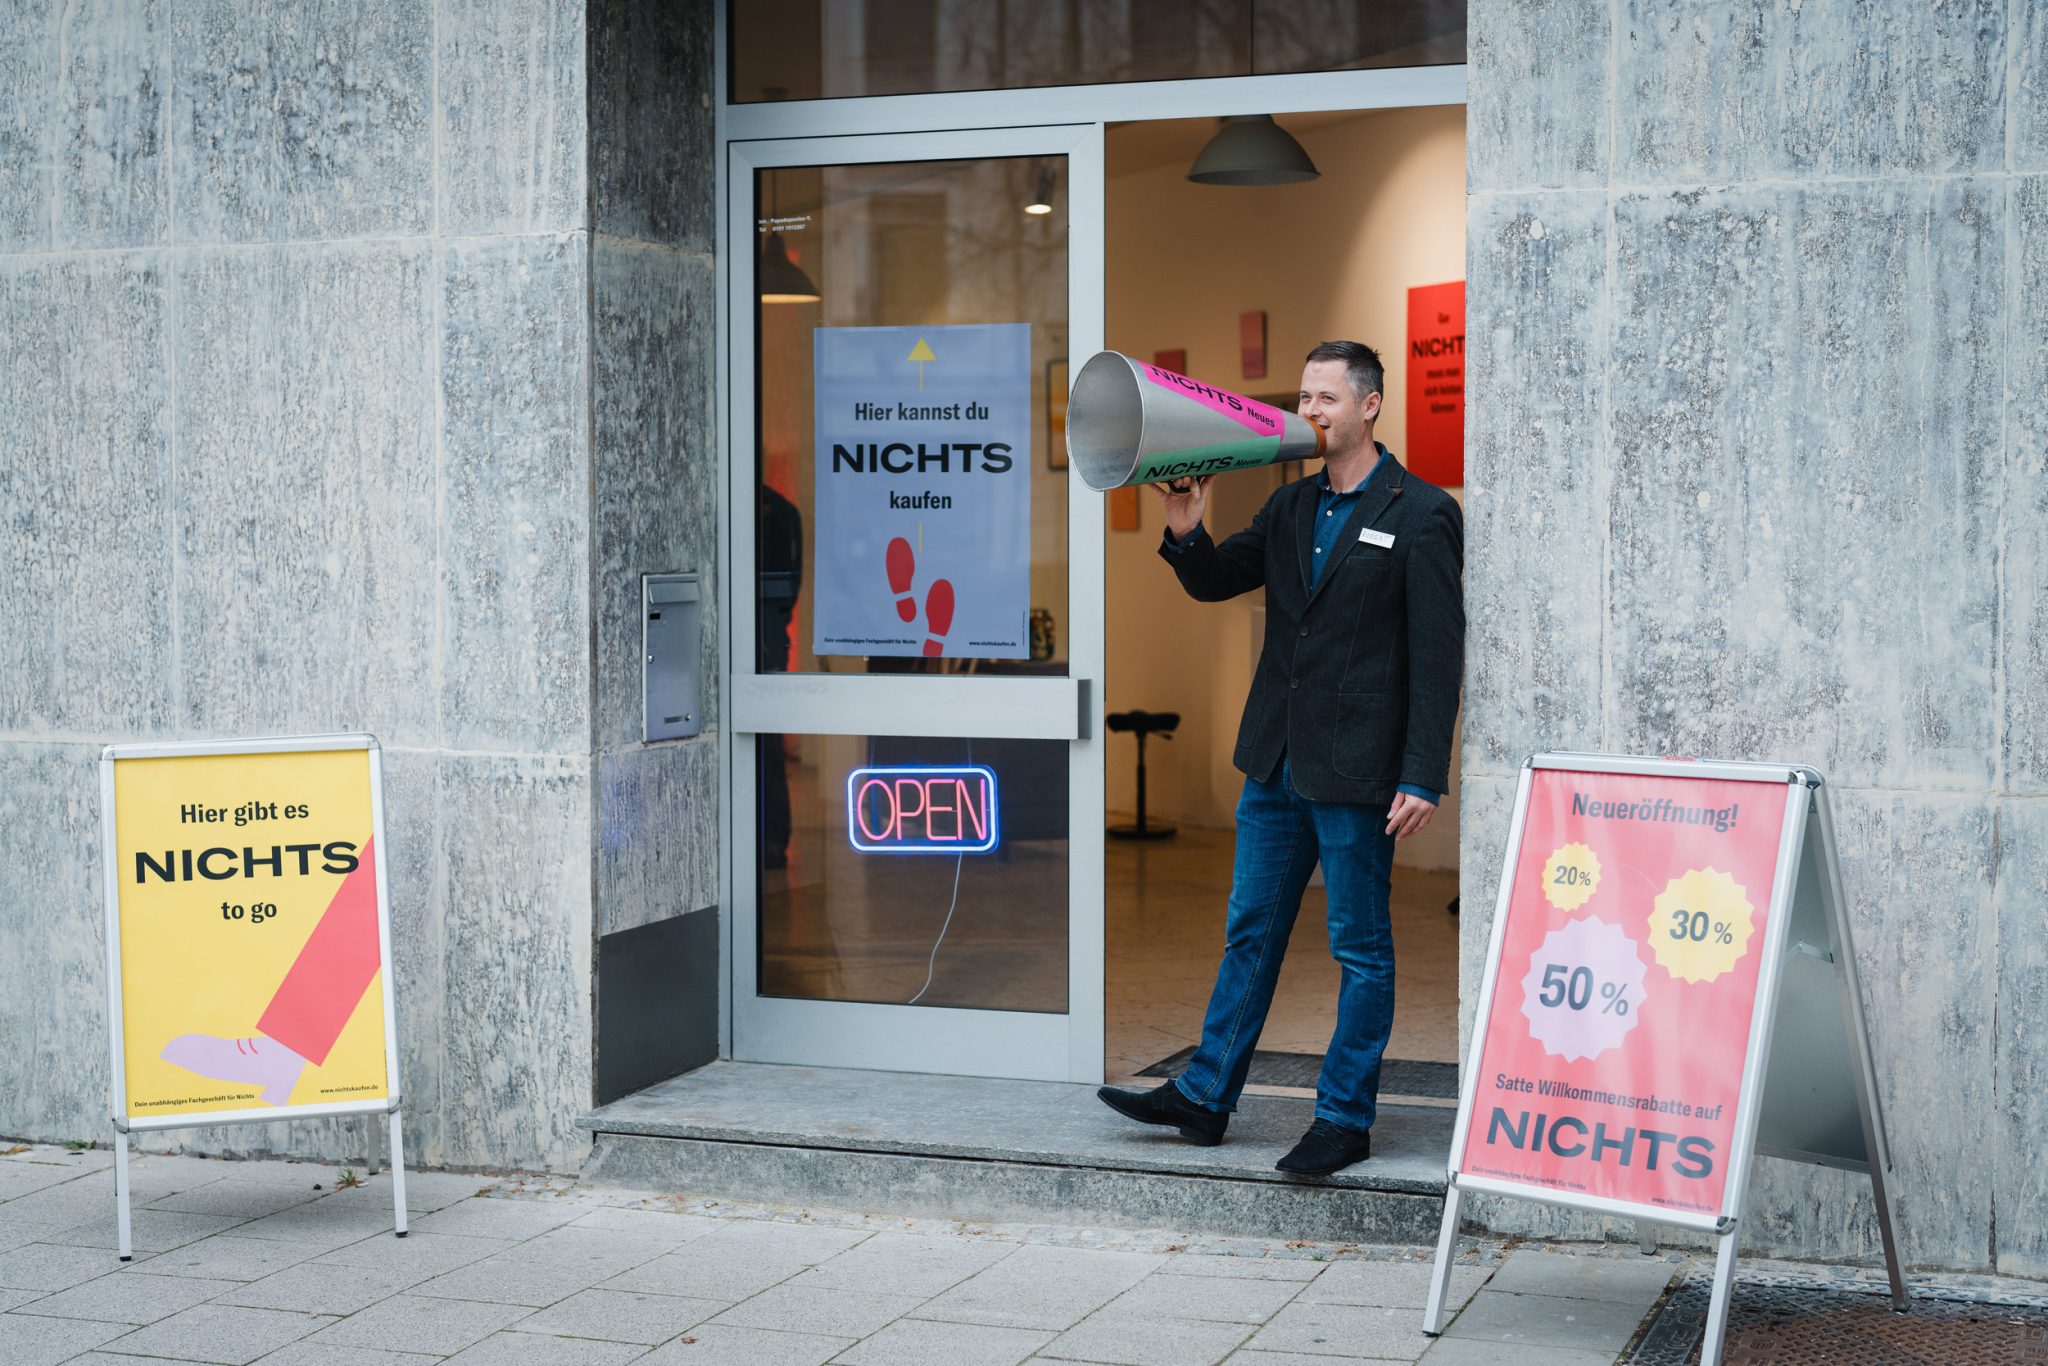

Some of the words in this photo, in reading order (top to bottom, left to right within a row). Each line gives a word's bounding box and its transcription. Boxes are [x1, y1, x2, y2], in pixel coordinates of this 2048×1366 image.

[1412, 335, 1465, 358] NICHT
[855, 402, 892, 420] Hier
[898, 402, 960, 420] kannst
[966, 402, 988, 420] du
[1150, 366, 1243, 412] NICHTS
[1247, 406, 1276, 428] Neues
[832, 442, 1012, 474] NICHTS
[1144, 456, 1234, 480] NICHTS
[890, 490, 952, 509] kaufen
[180, 804, 228, 823] Hier
[234, 802, 278, 826] gibt
[284, 804, 309, 820] es
[857, 779, 987, 840] OPEN
[1572, 792, 1739, 833] Neueröffnung!
[135, 841, 359, 884] NICHTS
[221, 901, 244, 920] to
[251, 902, 277, 924] go
[1495, 1072, 1534, 1094] Satte
[1538, 1078, 1692, 1118] Willkommensrabatte
[1696, 1104, 1722, 1122] auf
[1486, 1106, 1714, 1180] NICHTS
